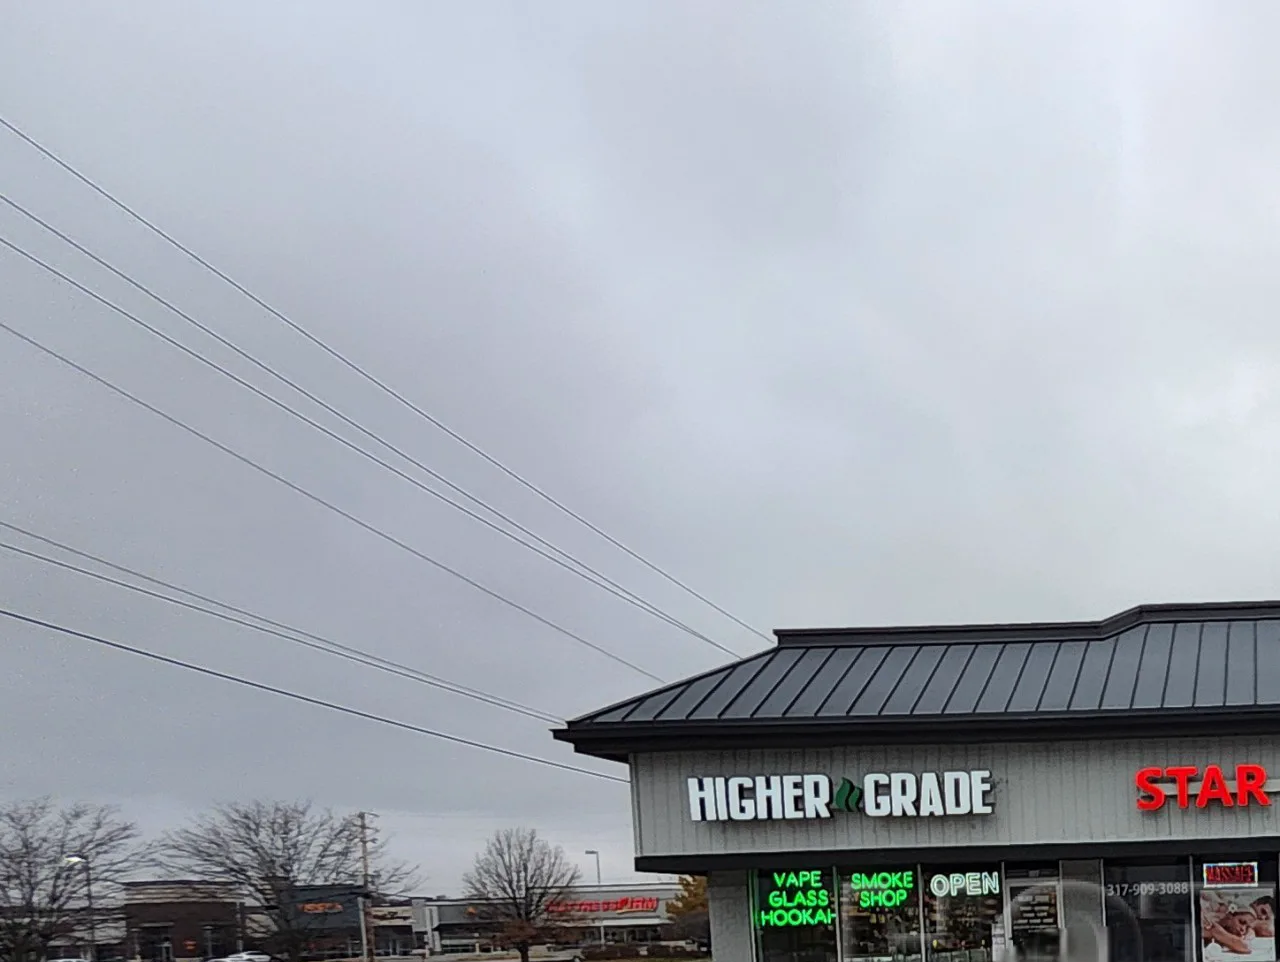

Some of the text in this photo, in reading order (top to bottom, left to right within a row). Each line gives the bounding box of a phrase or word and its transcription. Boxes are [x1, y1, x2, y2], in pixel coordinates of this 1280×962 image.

[688, 770, 993, 821] HIGHER GRADE
[1135, 764, 1272, 811] STAR
[773, 870, 822, 887] VAPE
[851, 871, 914, 890] SMOKE
[930, 871, 1000, 897] OPEN
[769, 889, 829, 907] GLASS
[859, 889, 907, 908] SHOP
[1107, 881, 1188, 897] 317-909-3088
